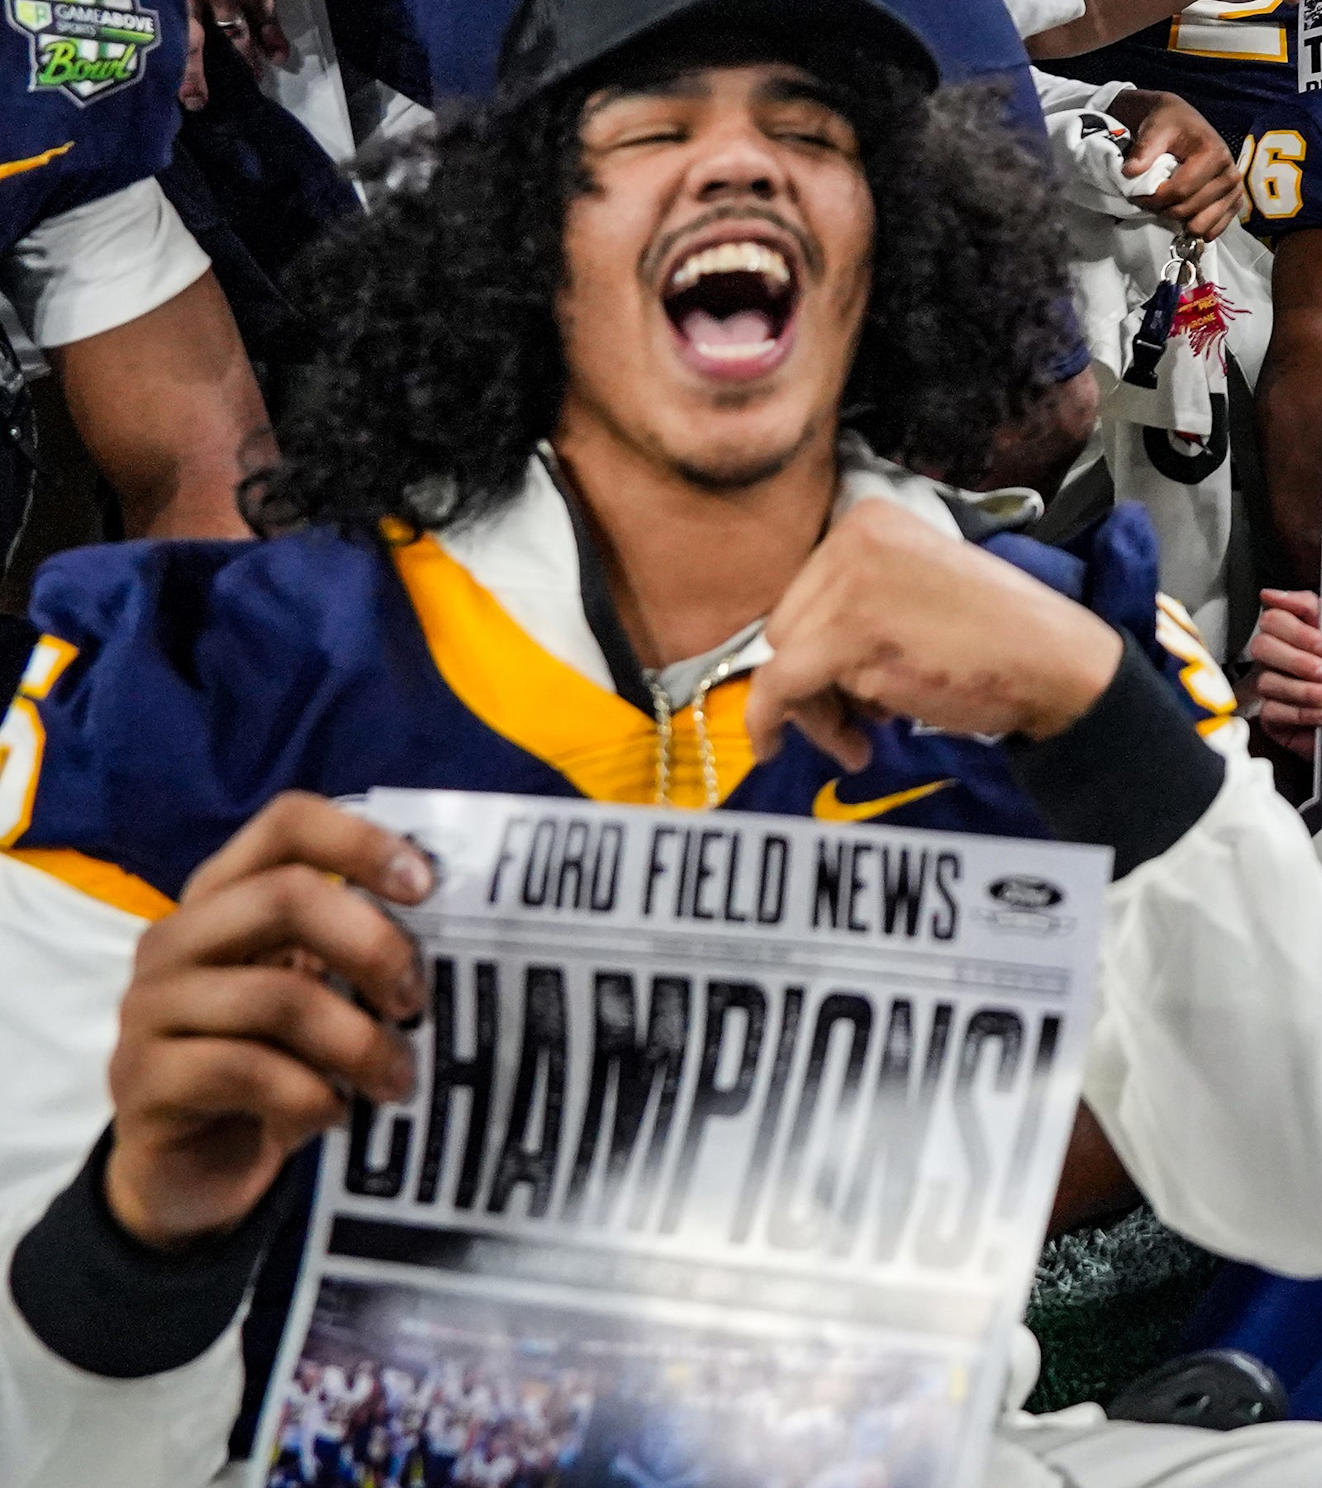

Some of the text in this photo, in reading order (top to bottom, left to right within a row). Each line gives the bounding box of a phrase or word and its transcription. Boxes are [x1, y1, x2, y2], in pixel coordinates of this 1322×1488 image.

[37, 40, 135, 86] Bowl
[488, 814, 963, 944] FORD FIELD NEWS
